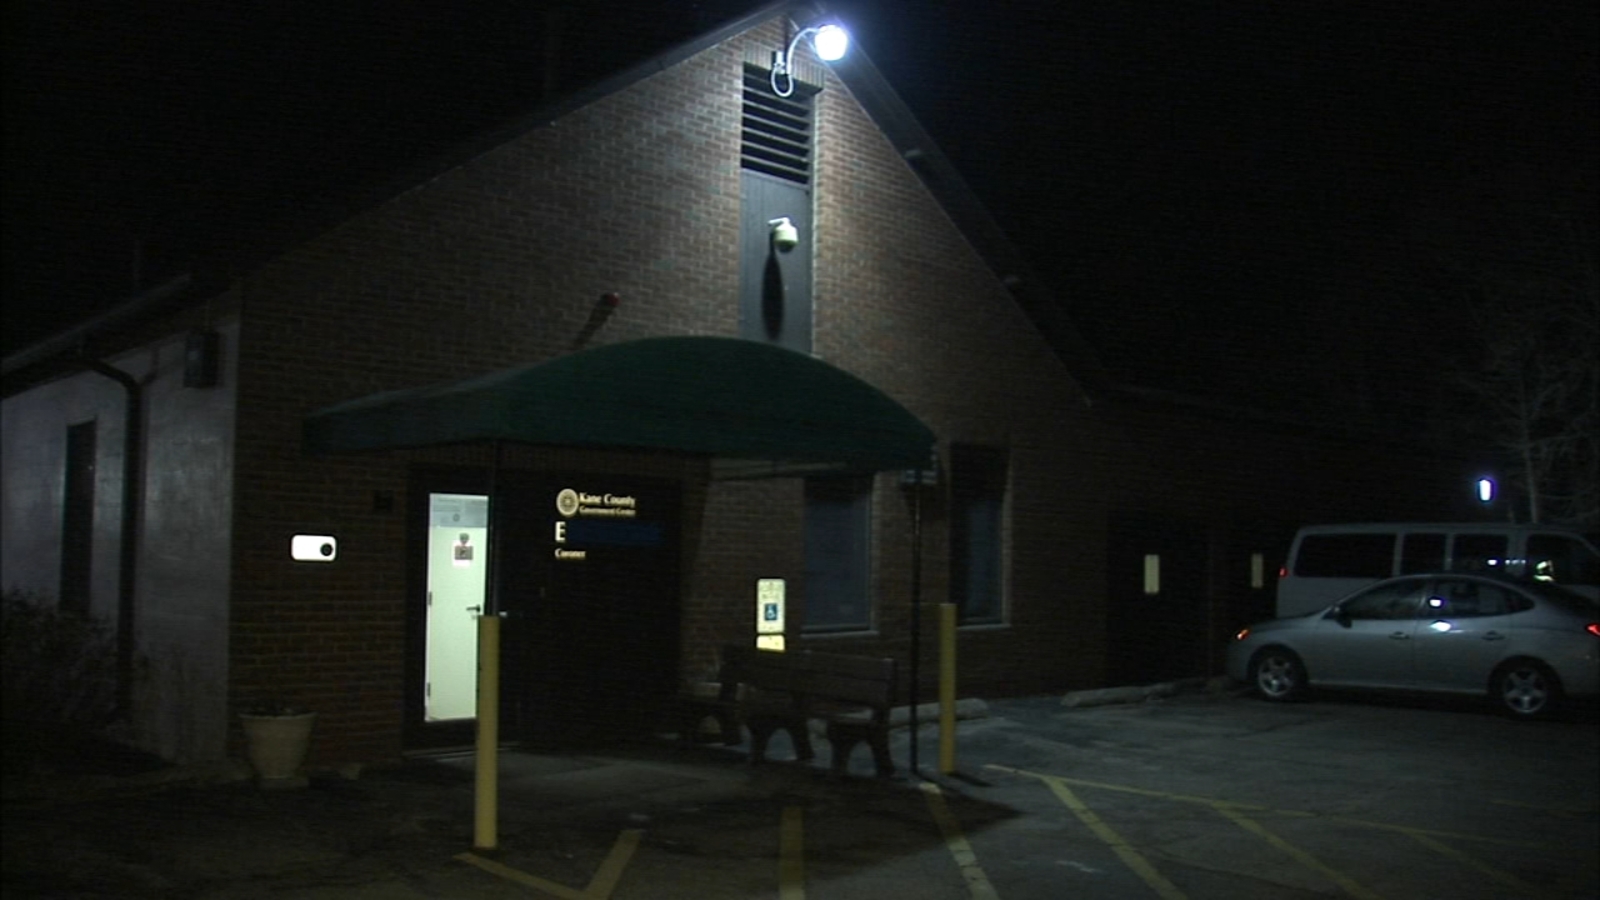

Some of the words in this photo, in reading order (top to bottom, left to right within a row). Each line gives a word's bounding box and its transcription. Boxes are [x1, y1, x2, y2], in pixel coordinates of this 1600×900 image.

[579, 492, 602, 505] Kane
[604, 493, 636, 508] County
[555, 521, 566, 543] E
[555, 548, 587, 560] Coroner
